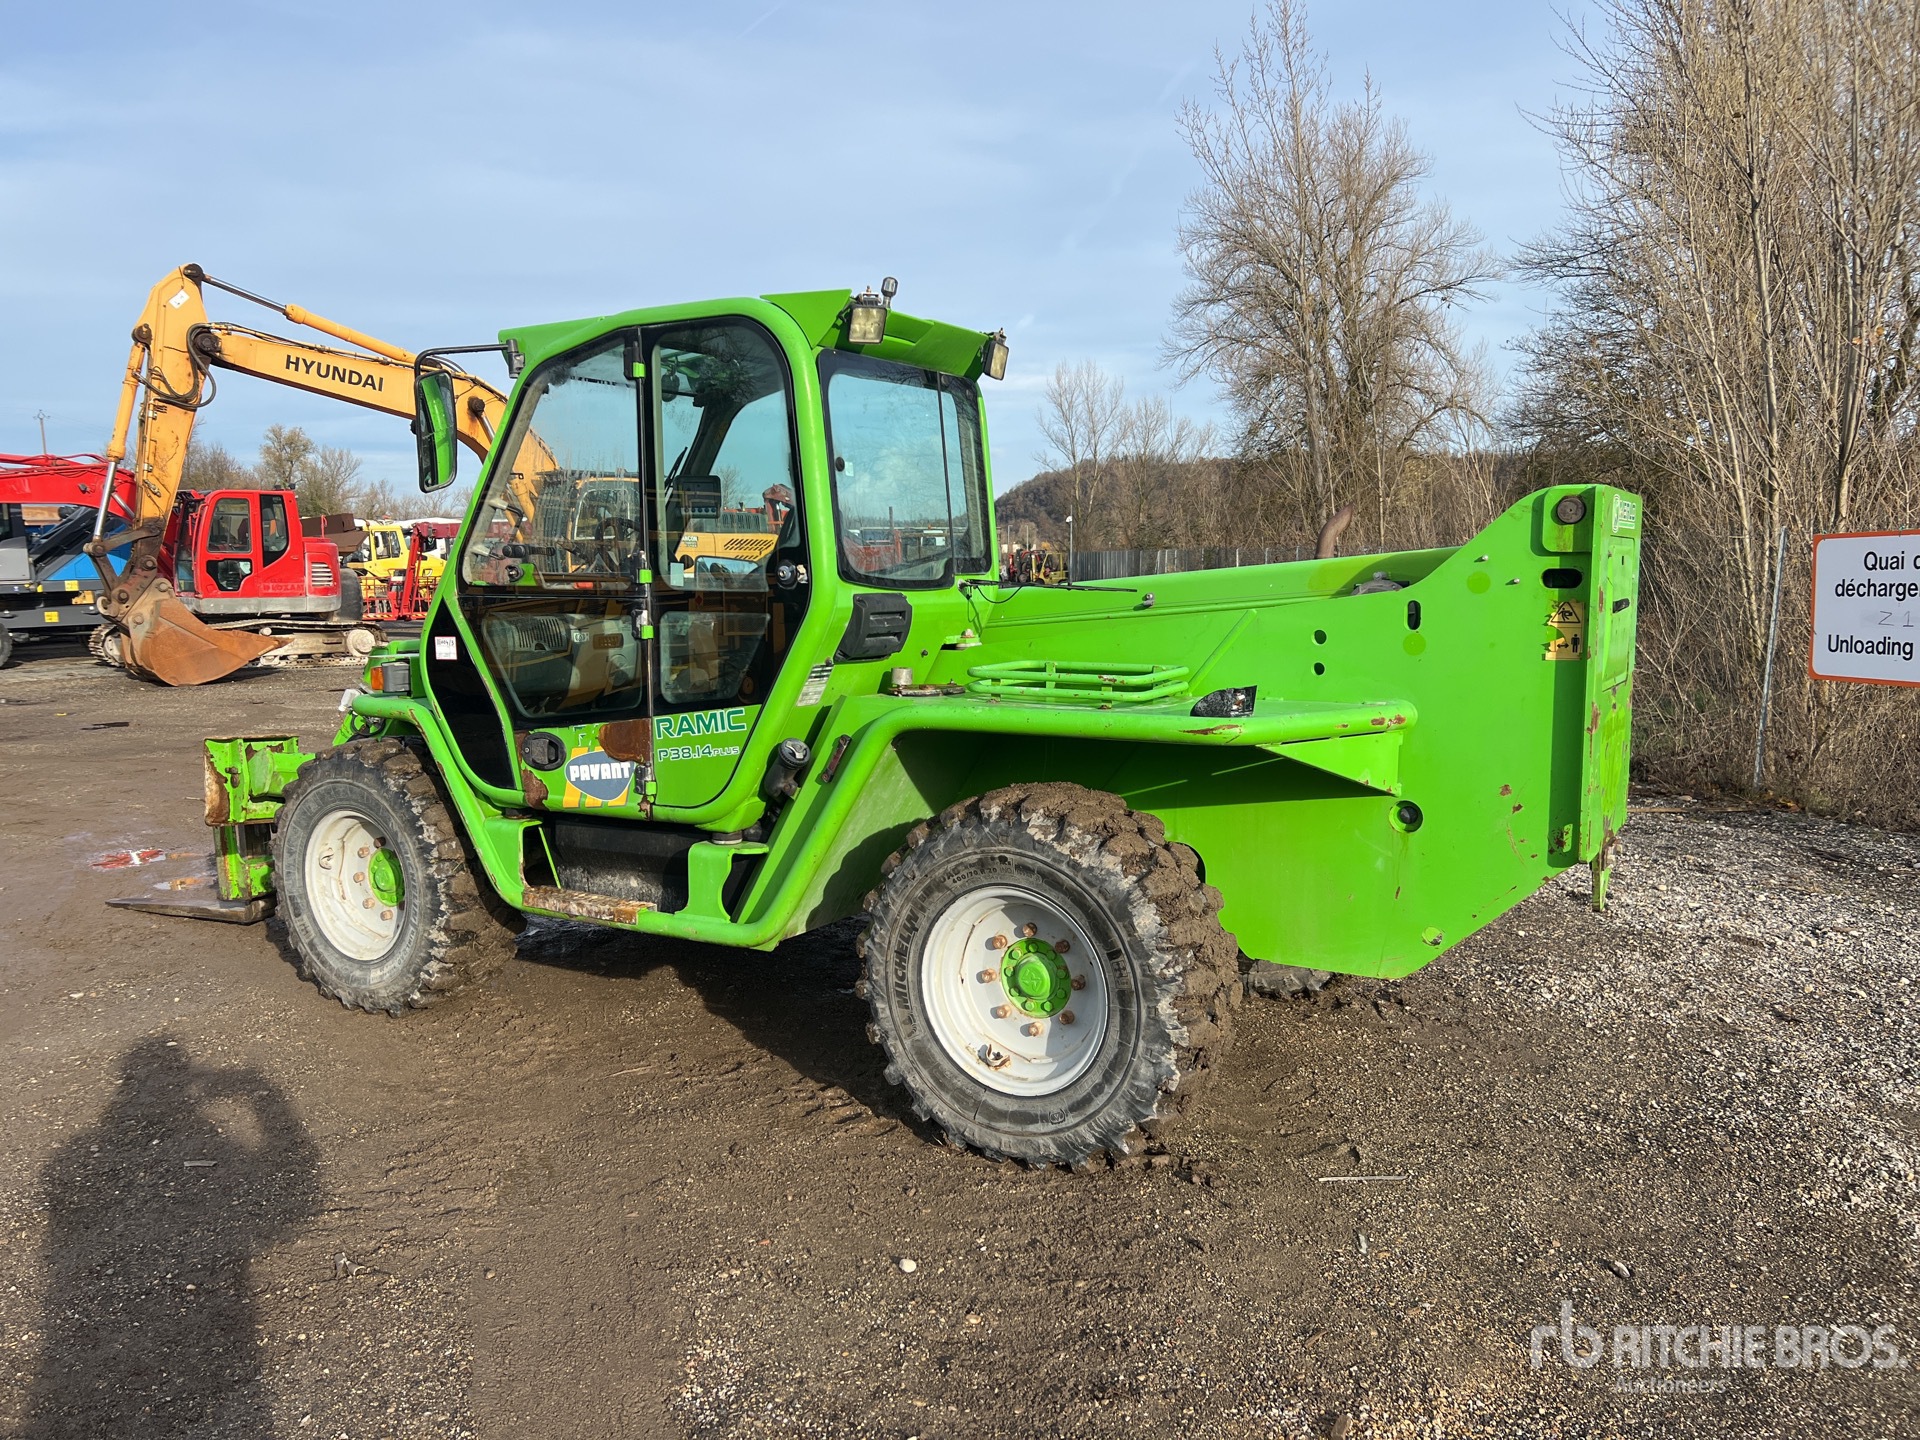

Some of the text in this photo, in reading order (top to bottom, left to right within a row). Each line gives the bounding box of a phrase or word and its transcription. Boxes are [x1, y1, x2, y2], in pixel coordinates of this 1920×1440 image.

[285, 354, 384, 392] HYUNDAI
[1863, 551, 1905, 571] Quai
[1835, 579, 1920, 601] décharge
[1828, 634, 1914, 661] Unloading
[569, 762, 631, 781] PAYANT
[952, 870, 978, 883] 400/70
[894, 907, 919, 1010] MICHELIN
